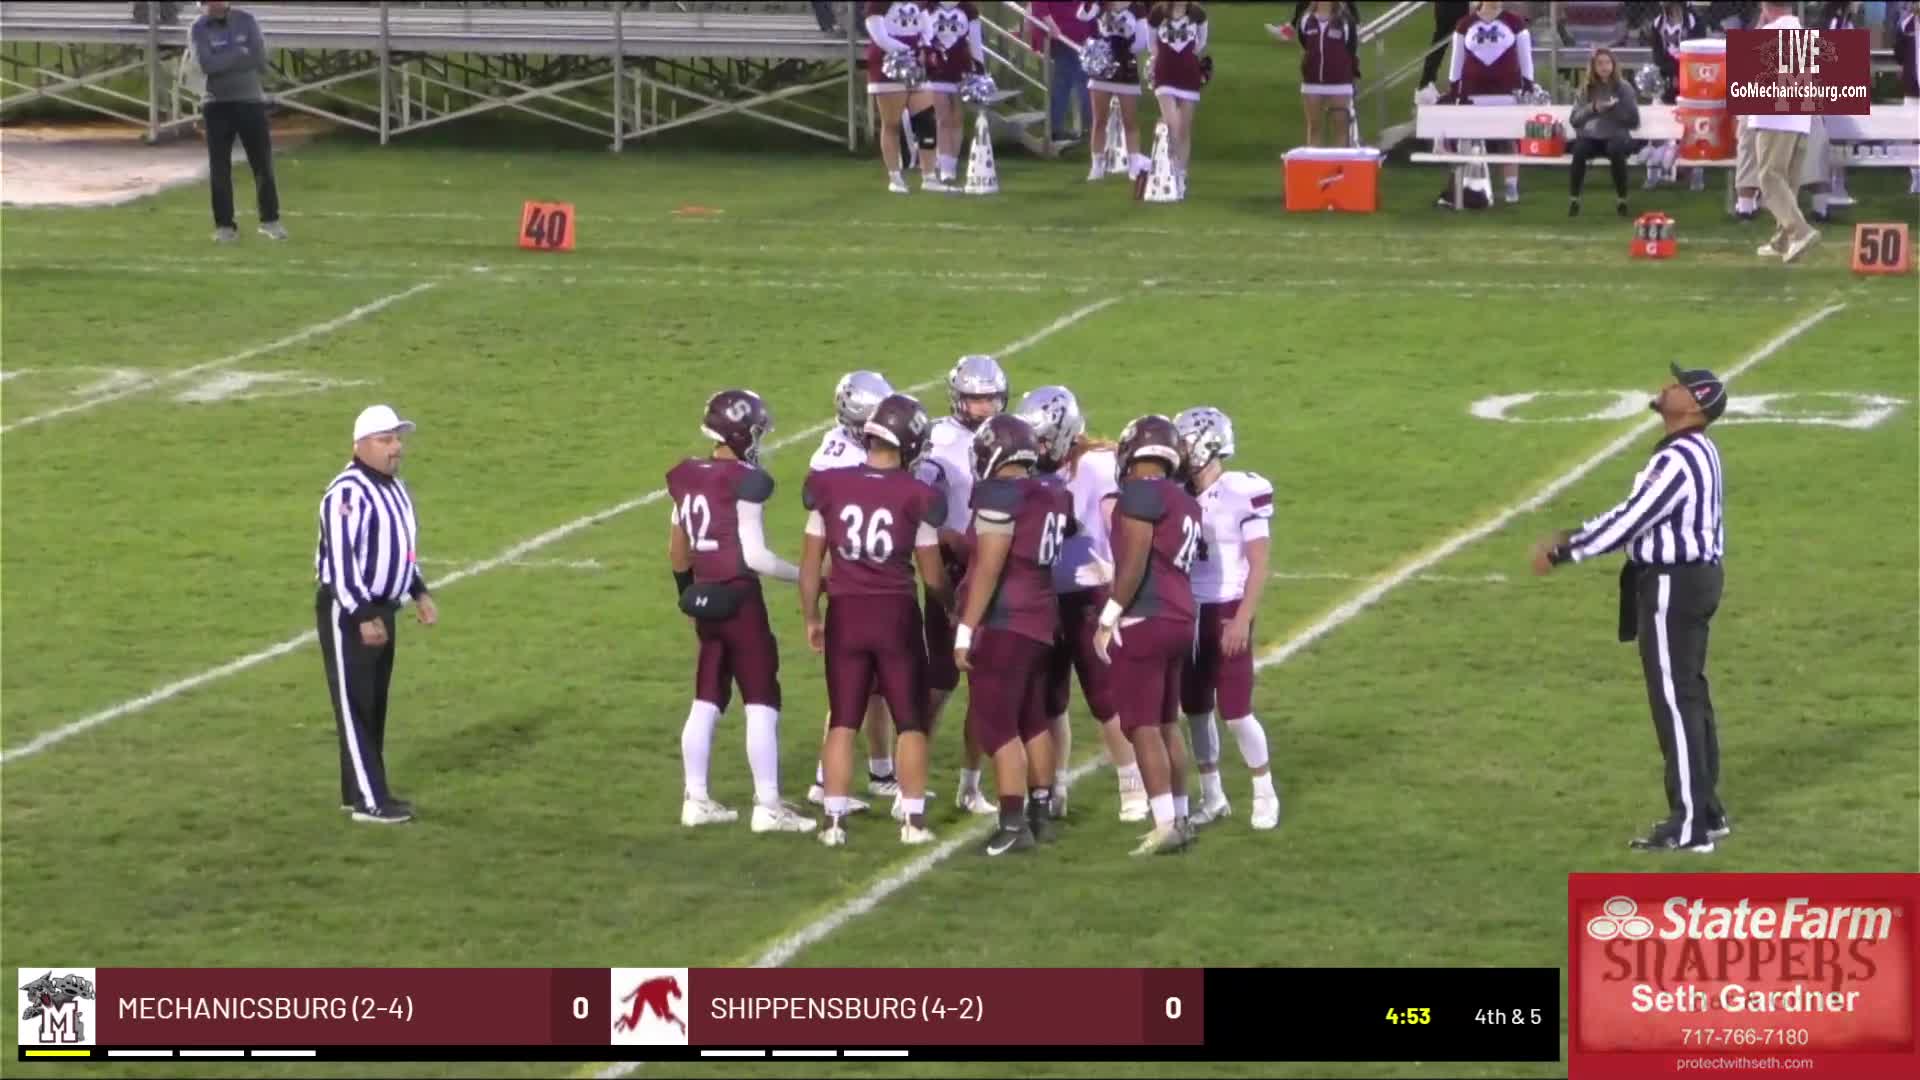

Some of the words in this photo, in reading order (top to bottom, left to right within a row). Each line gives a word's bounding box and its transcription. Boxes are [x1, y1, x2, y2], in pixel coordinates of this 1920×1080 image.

[525, 207, 566, 247] 40
[1859, 228, 1901, 266] 50
[725, 399, 751, 423] S
[824, 440, 846, 457] 23
[680, 493, 719, 551] 12
[837, 503, 894, 563] 36
